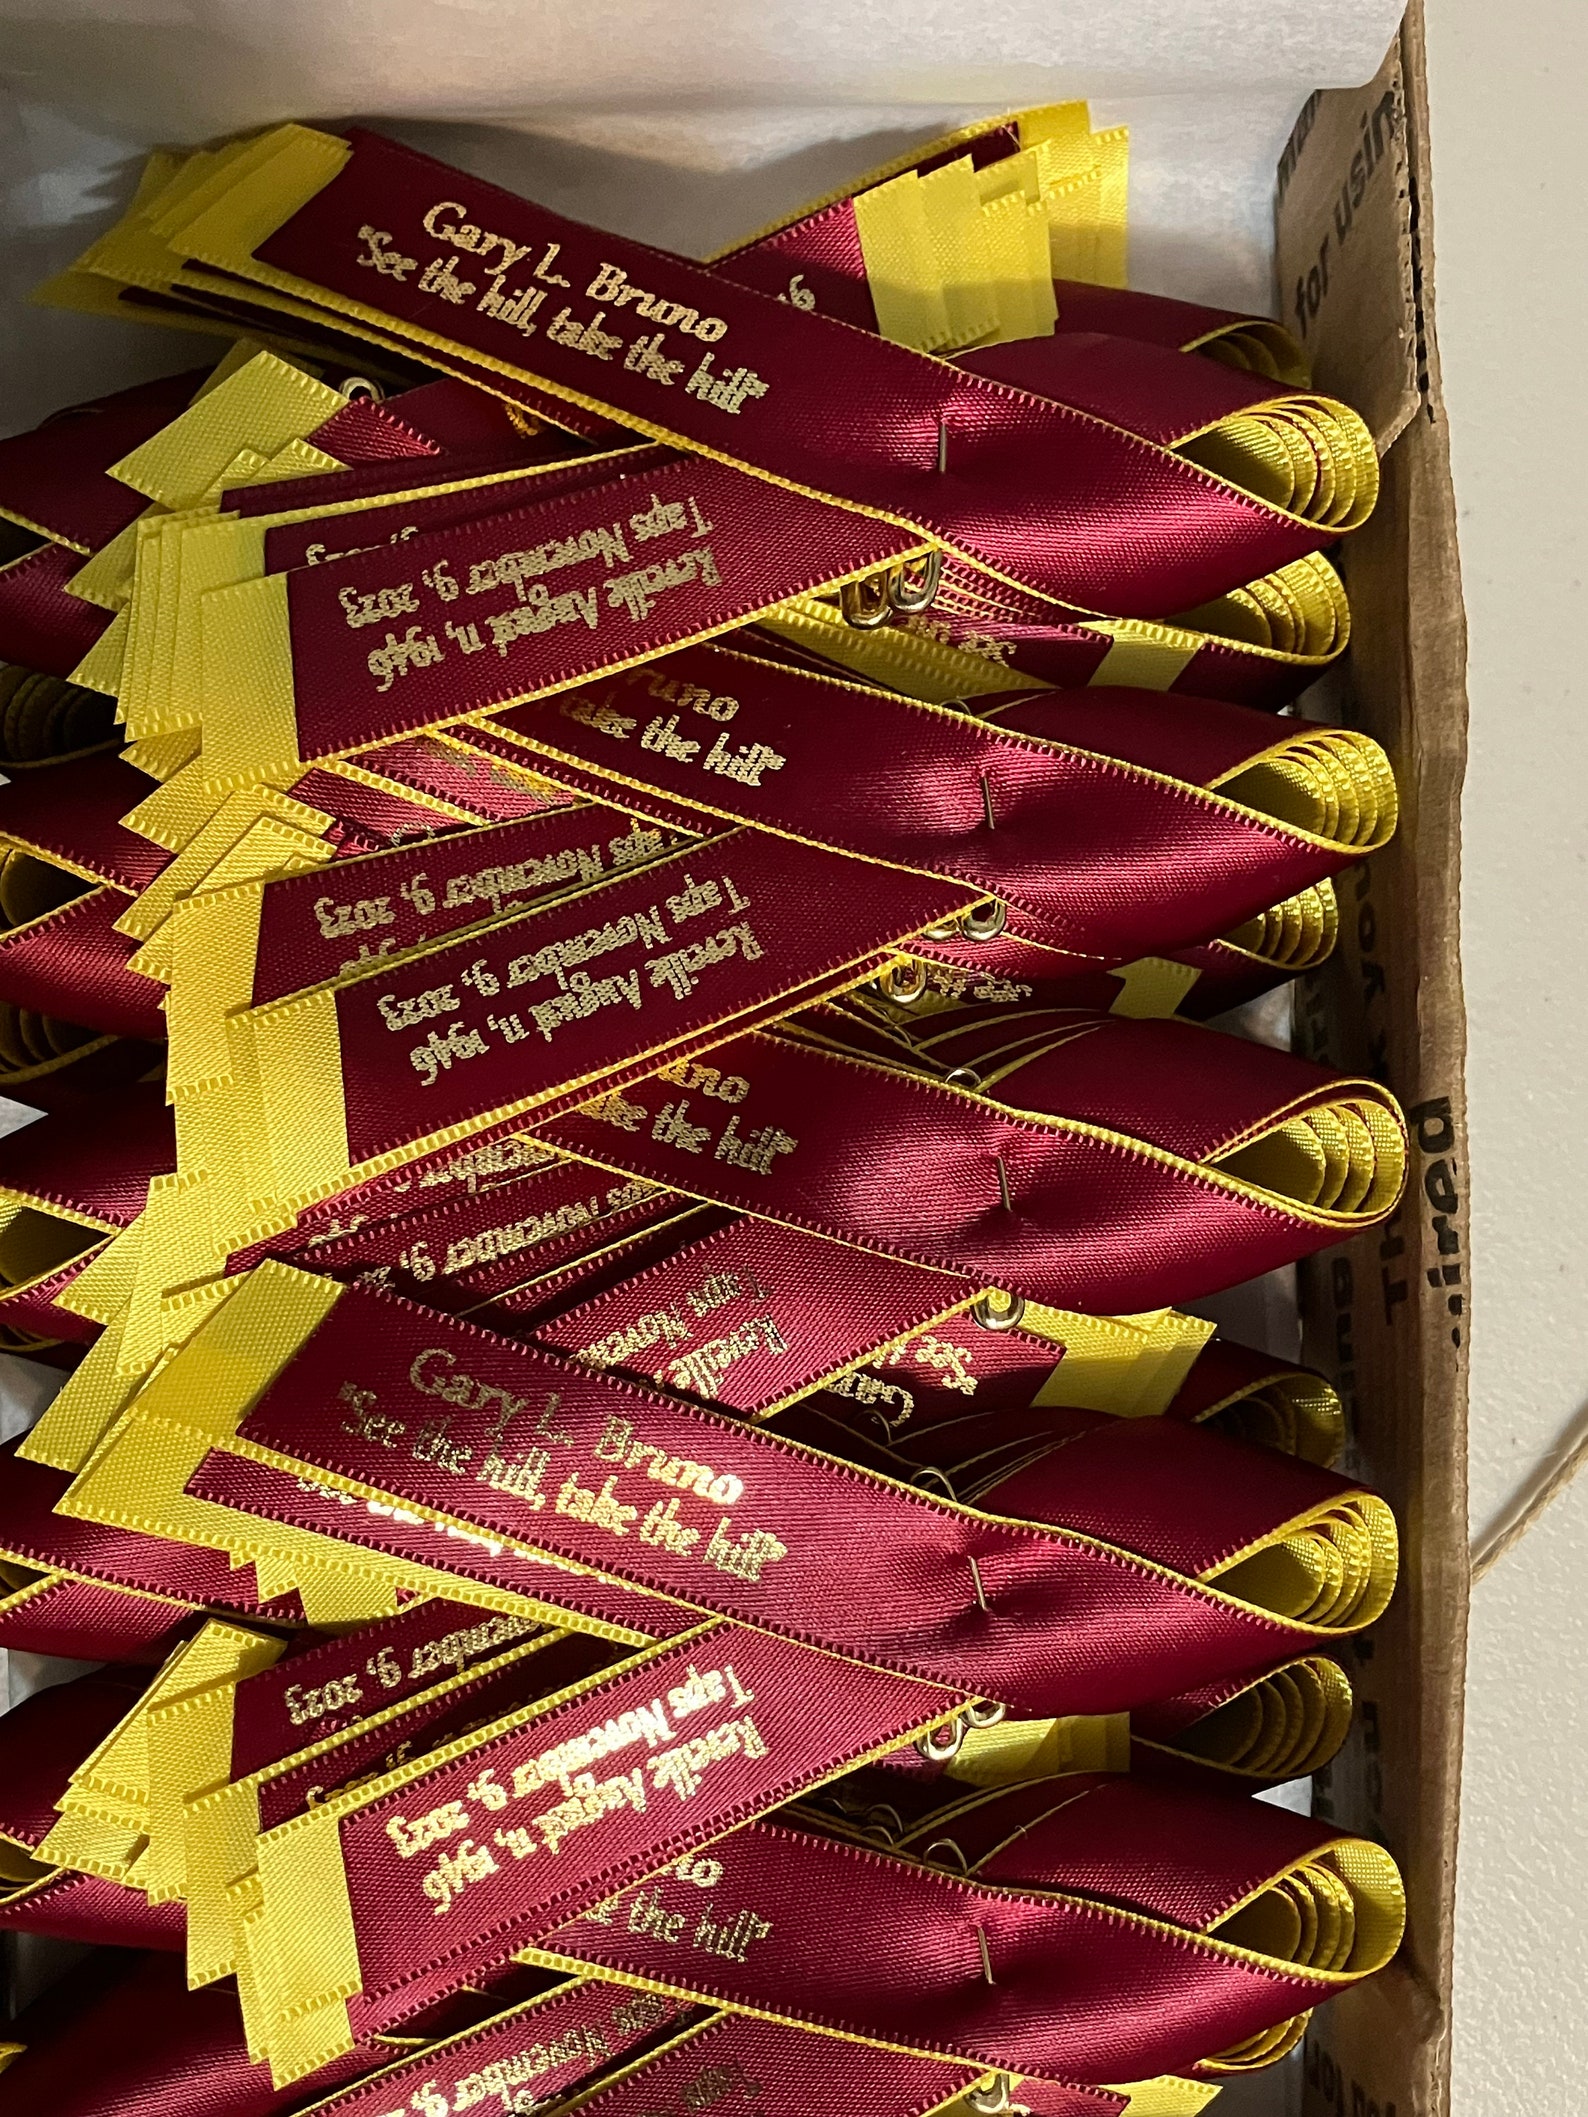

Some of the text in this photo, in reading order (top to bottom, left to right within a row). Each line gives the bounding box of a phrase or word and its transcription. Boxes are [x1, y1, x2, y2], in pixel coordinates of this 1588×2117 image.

[423, 201, 728, 342] Gary L. Bruno
[418, 255, 477, 305] the
[477, 274, 547, 337] hill,
[546, 305, 624, 361] take
[623, 332, 684, 386] the
[630, 493, 713, 540] Taps
[422, 560, 460, 602] 9,
[469, 523, 633, 602] November
[338, 580, 421, 629] 2023
[489, 582, 600, 657] August
[641, 712, 702, 763] the
[313, 896, 397, 940] 2023
[400, 871, 437, 914] 9,
[377, 873, 751, 1032] Taps November 9, 2023
[528, 967, 641, 1042] August
[651, 1099, 711, 1155] the
[409, 1347, 744, 1505] Gary L. Bruno
[412, 1415, 473, 1476] the
[555, 1472, 637, 1537] take
[639, 1497, 700, 1558] the
[366, 1645, 402, 1690] 9,
[670, 1663, 754, 1719] Taps
[283, 1673, 363, 1727] 2023
[513, 1698, 675, 1798] November
[386, 1801, 470, 1858] 2023
[627, 1886, 685, 1943] the
